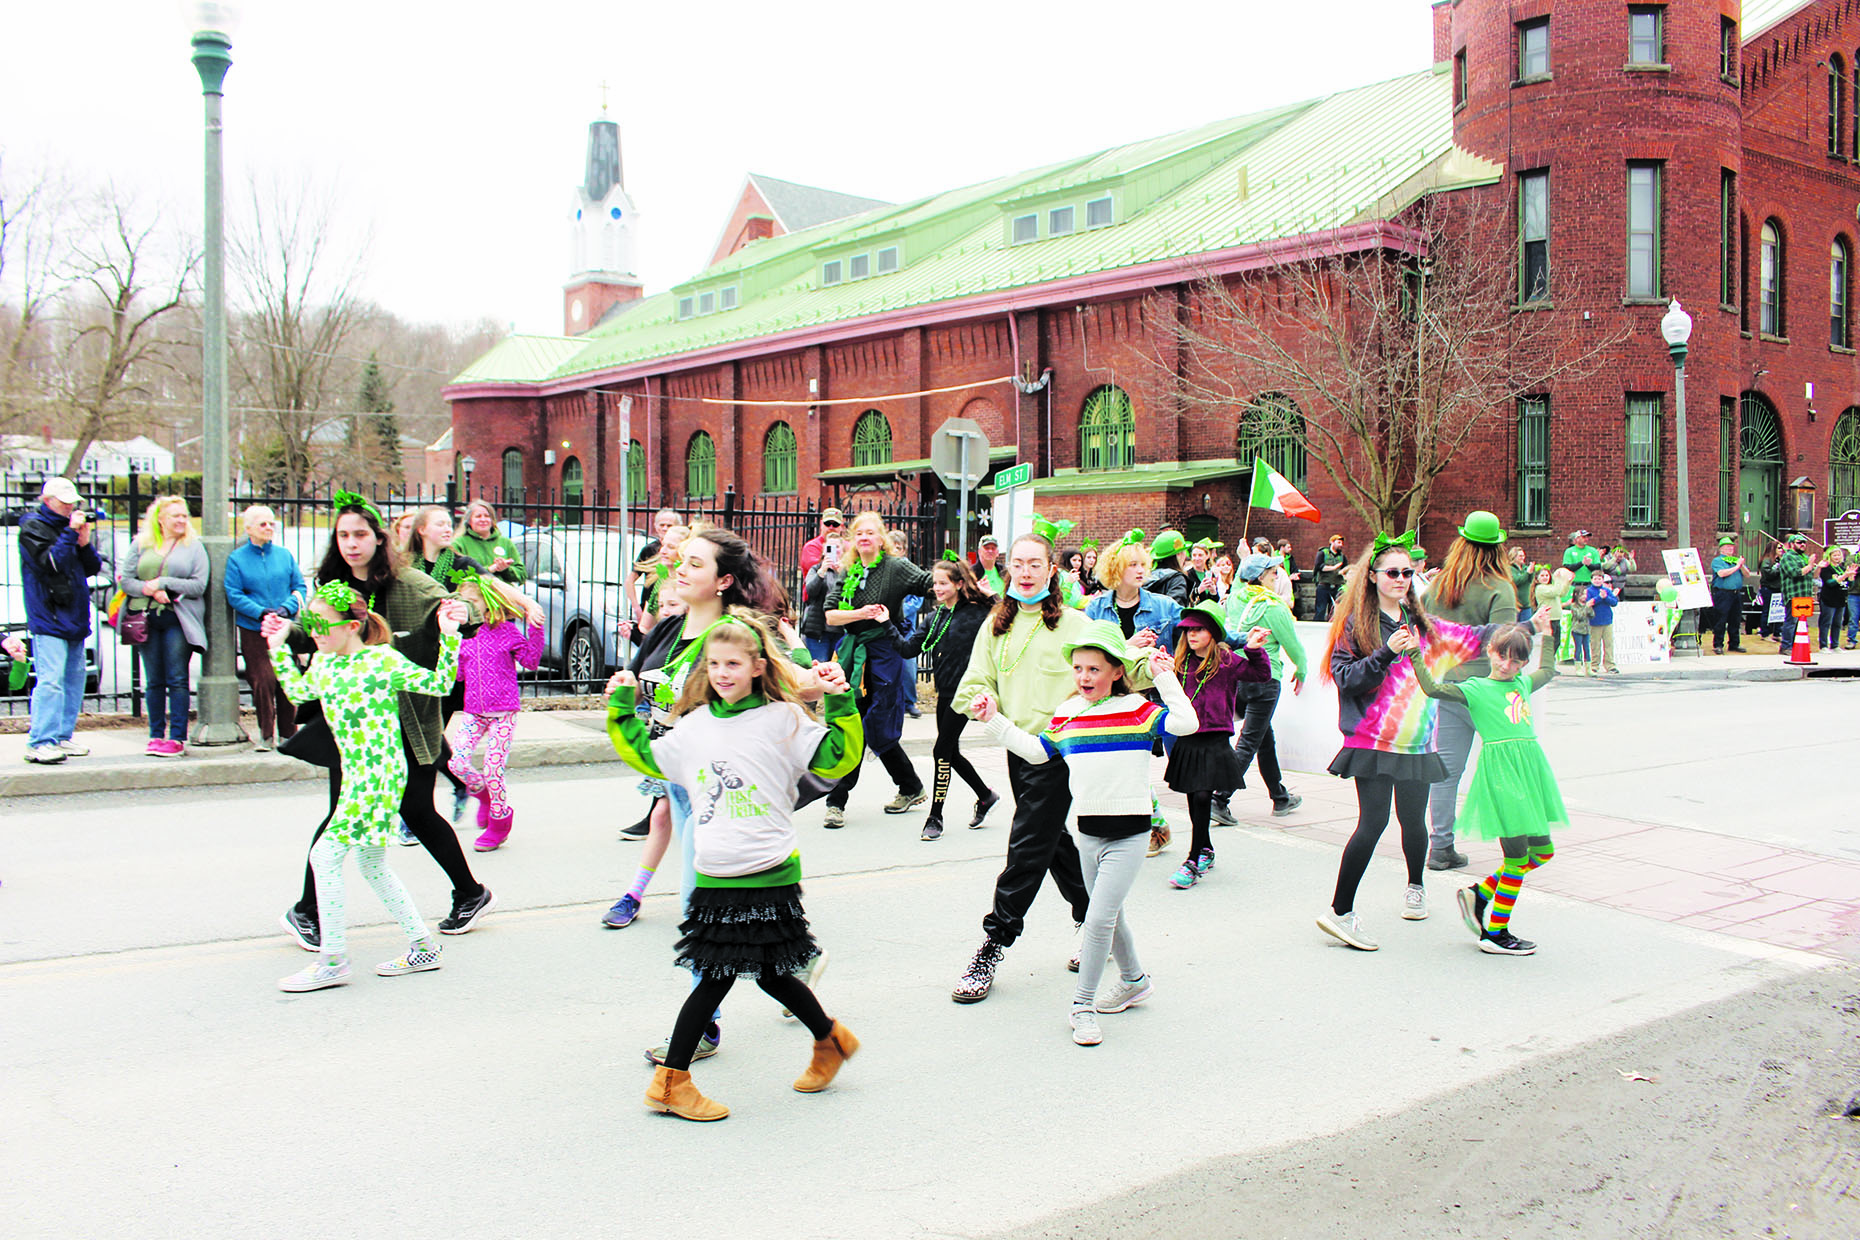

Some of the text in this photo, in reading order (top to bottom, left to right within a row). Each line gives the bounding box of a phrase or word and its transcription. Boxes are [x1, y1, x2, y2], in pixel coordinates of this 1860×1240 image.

[999, 469, 1024, 486] ELM ST
[1770, 599, 1785, 608] FFA
[934, 758, 950, 803] JUSTICE
